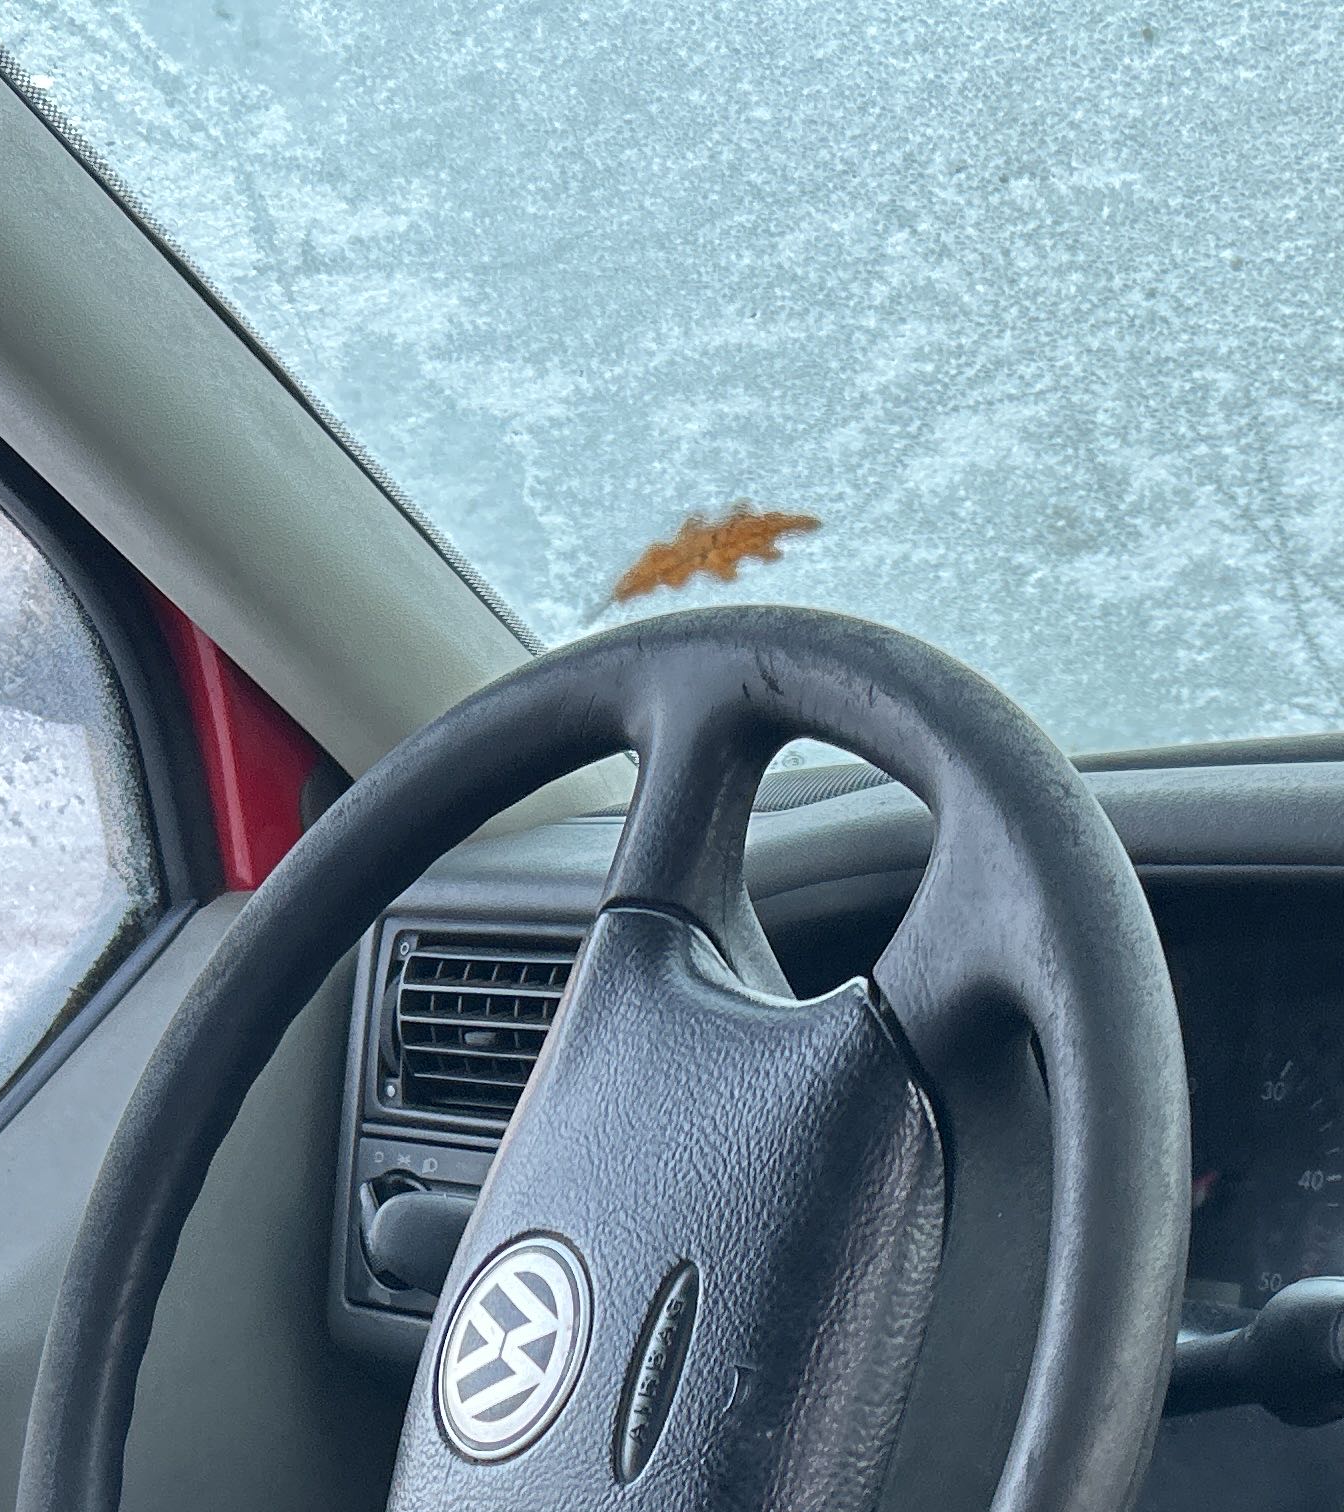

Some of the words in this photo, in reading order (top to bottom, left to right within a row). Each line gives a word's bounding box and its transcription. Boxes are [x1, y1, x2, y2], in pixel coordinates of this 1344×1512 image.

[1262, 1081, 1287, 1101] 30
[1299, 1170, 1324, 1190] 40
[1259, 1272, 1283, 1292] 50
[630, 1298, 683, 1441] AIRBAG
